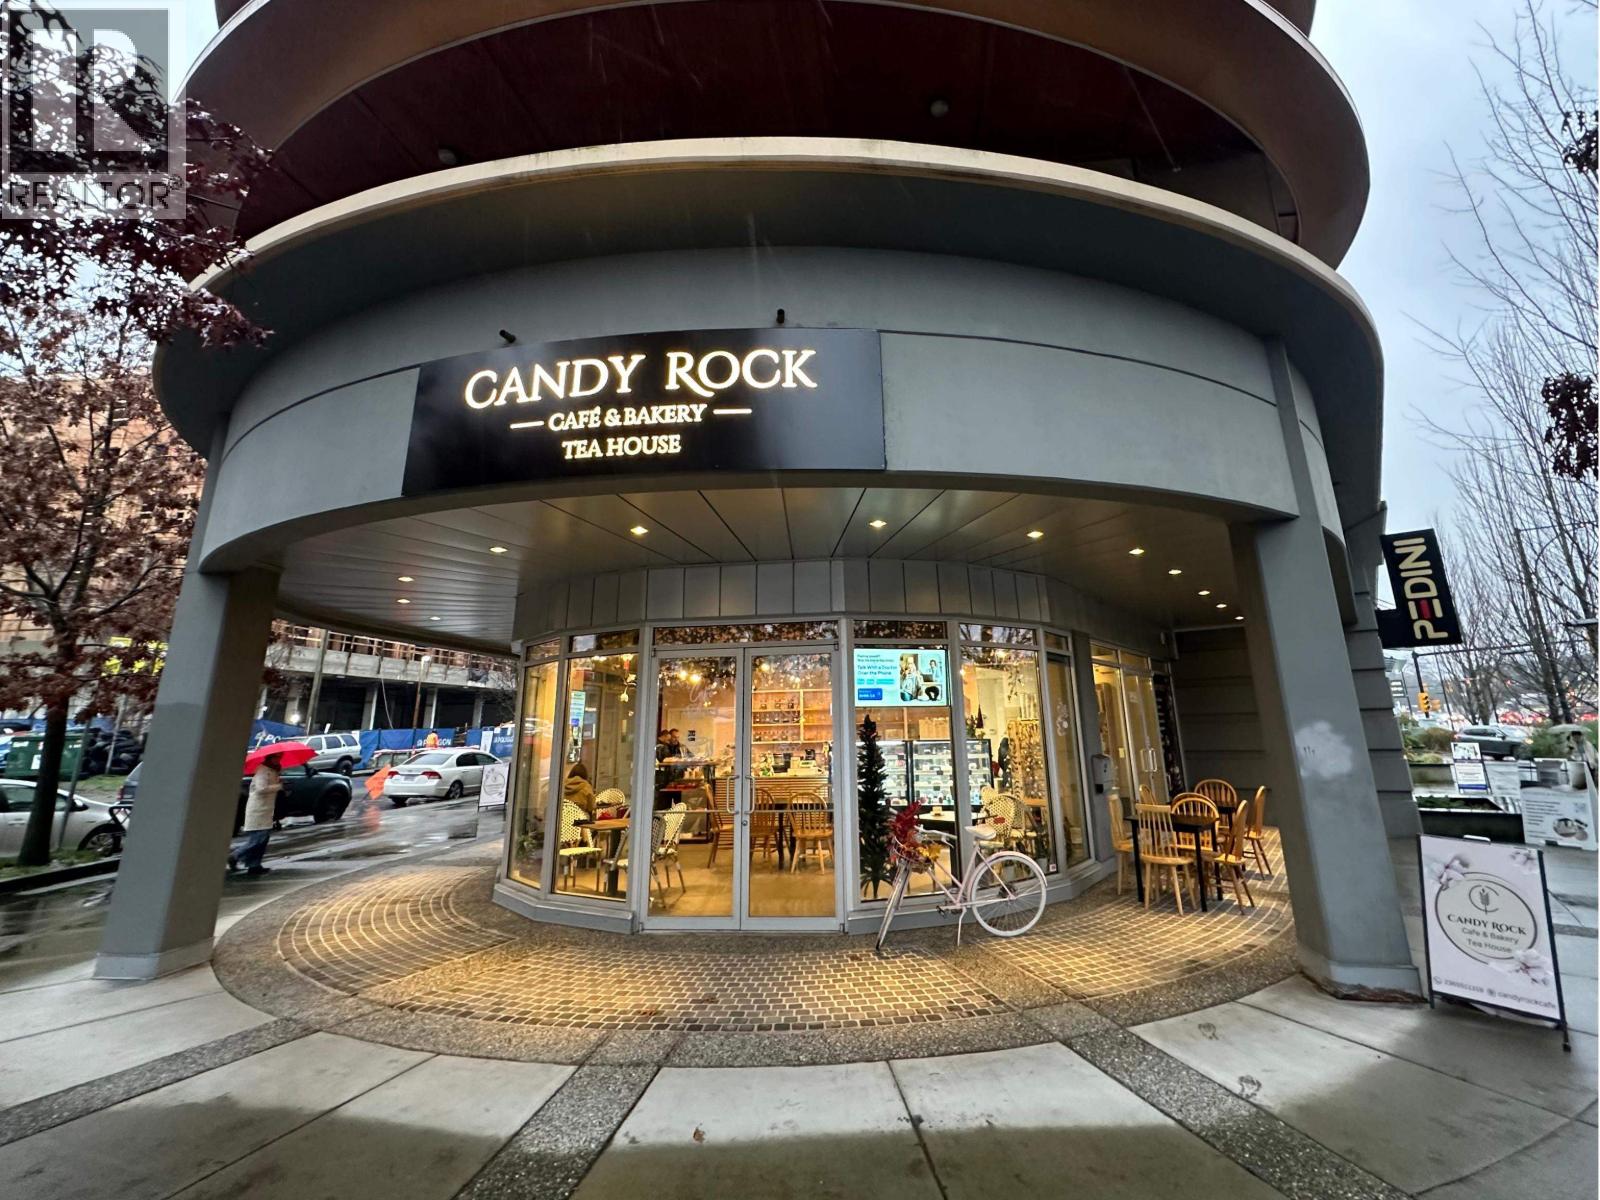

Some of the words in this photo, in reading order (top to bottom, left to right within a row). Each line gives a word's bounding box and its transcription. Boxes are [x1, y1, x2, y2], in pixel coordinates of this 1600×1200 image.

[465, 354, 646, 409] CANDY
[665, 349, 818, 397] ROCK
[548, 405, 601, 431] CAFÉ
[604, 408, 622, 427] &
[623, 404, 708, 426] BAKERY
[562, 439, 603, 460] TEA
[606, 434, 682, 457] HOUSE
[1393, 537, 1449, 640] PEDINI
[1447, 914, 1488, 928] CANDY
[1492, 922, 1527, 935] ROCK
[1467, 938, 1482, 948] Tea
[1484, 942, 1512, 953] House
[1490, 932, 1519, 945] Bakery
